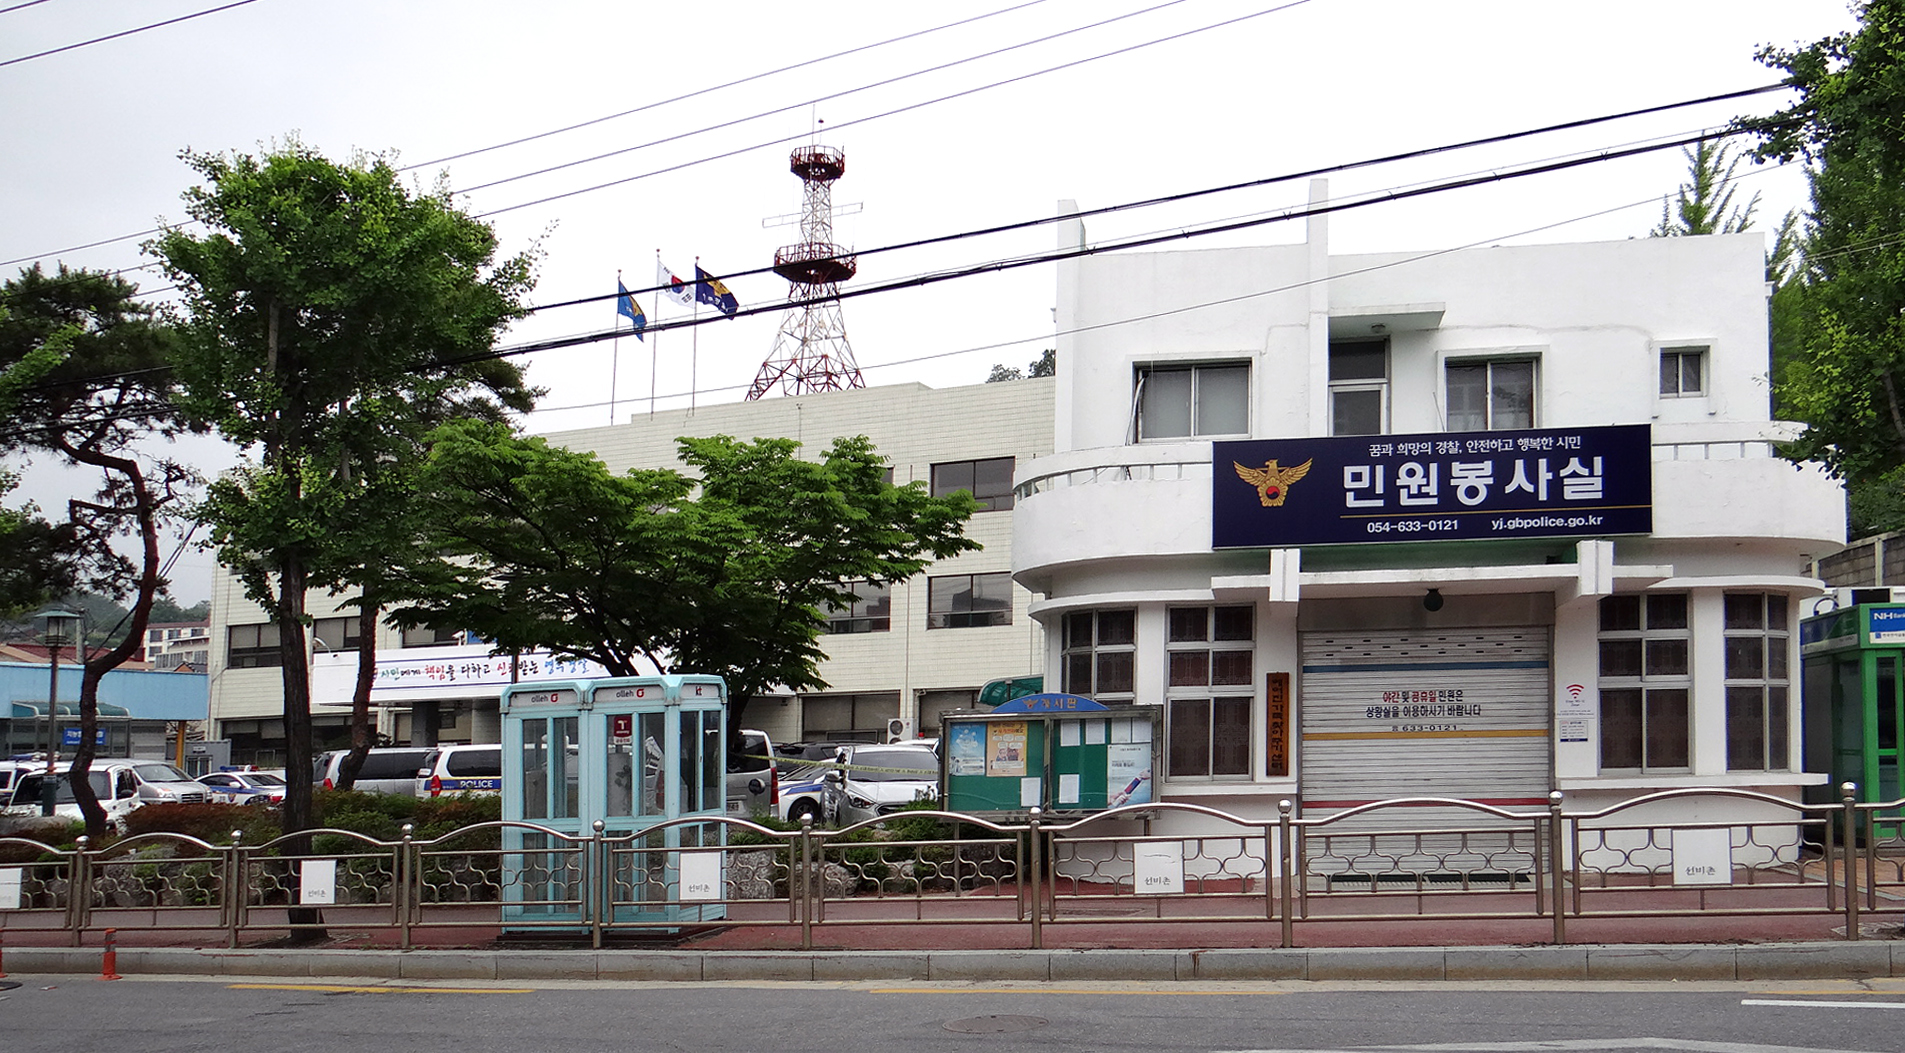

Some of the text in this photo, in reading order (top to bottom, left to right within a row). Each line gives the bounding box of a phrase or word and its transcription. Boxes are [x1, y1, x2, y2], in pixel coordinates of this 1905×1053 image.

[1369, 435, 1581, 457] 꿈과 희망의 경찰, 안전하고 행복한 시민
[1343, 456, 1603, 508] 민원봉사실
[1366, 519, 1459, 533] 054-633-0121
[1491, 515, 1603, 531] yj.gbpolice.go.kr
[1873, 612, 1893, 620] NH
[381, 667, 422, 680] 시민에게
[425, 664, 456, 681] 책임을
[461, 663, 490, 678] 다하고
[531, 694, 549, 703] olleh
[616, 689, 634, 698] olleh
[1382, 689, 1464, 703] 야간 및 공휴일 민원은
[1041, 698, 1078, 709] 게시판
[1366, 704, 1482, 718] 상황실을 이용하시기 바랍니다
[460, 780, 493, 788] POLICE
[1685, 866, 1716, 876] 선비촌
[1144, 876, 1171, 885] 선비촌
